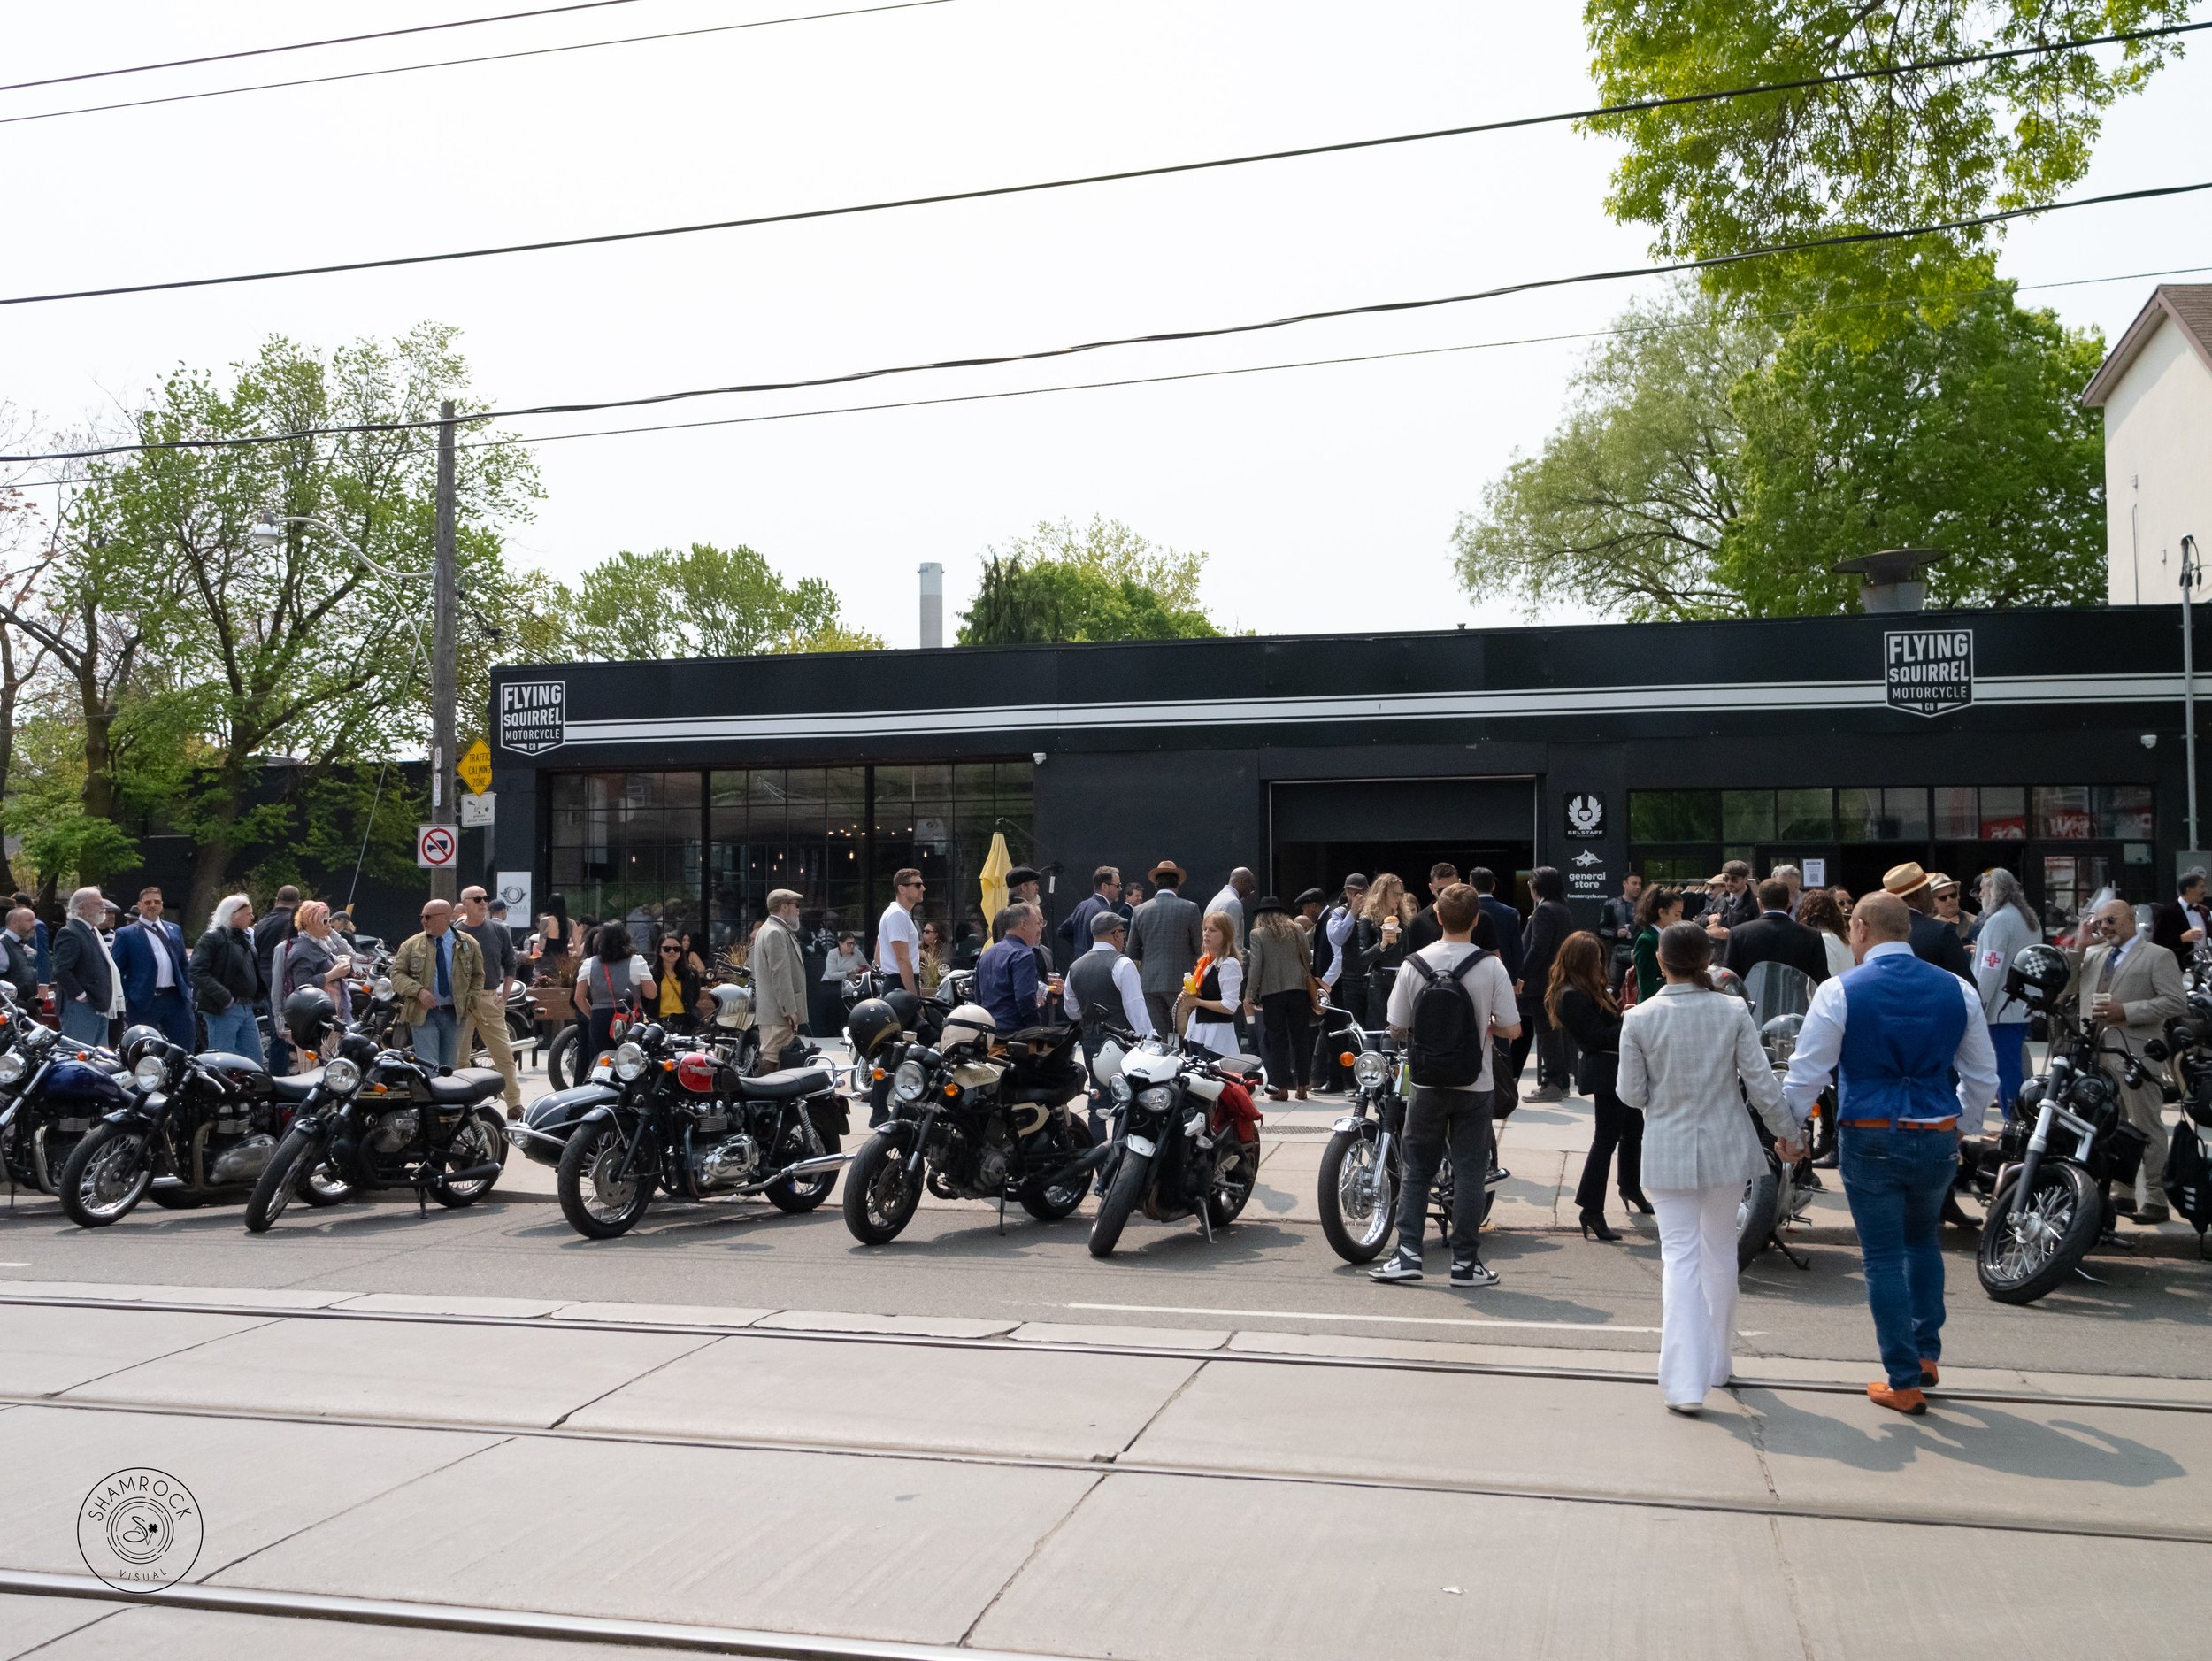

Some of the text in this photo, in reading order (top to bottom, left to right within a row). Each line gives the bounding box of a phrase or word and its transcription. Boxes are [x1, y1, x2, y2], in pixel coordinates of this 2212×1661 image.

[1889, 634, 1968, 664] FLYING
[1889, 660, 1970, 683] SQUIRREL
[503, 684, 562, 711] FLYING
[1892, 686, 1967, 699] MOTORCYCLE
[1924, 702, 1934, 711] CO
[503, 707, 562, 727] SQUIRREL
[505, 728, 560, 741] MOTORCYCLE
[469, 752, 491, 763] TRAFFIC
[468, 765, 491, 775] CALMING
[473, 777, 486, 788] ZONE
[1569, 872, 1606, 881] general
